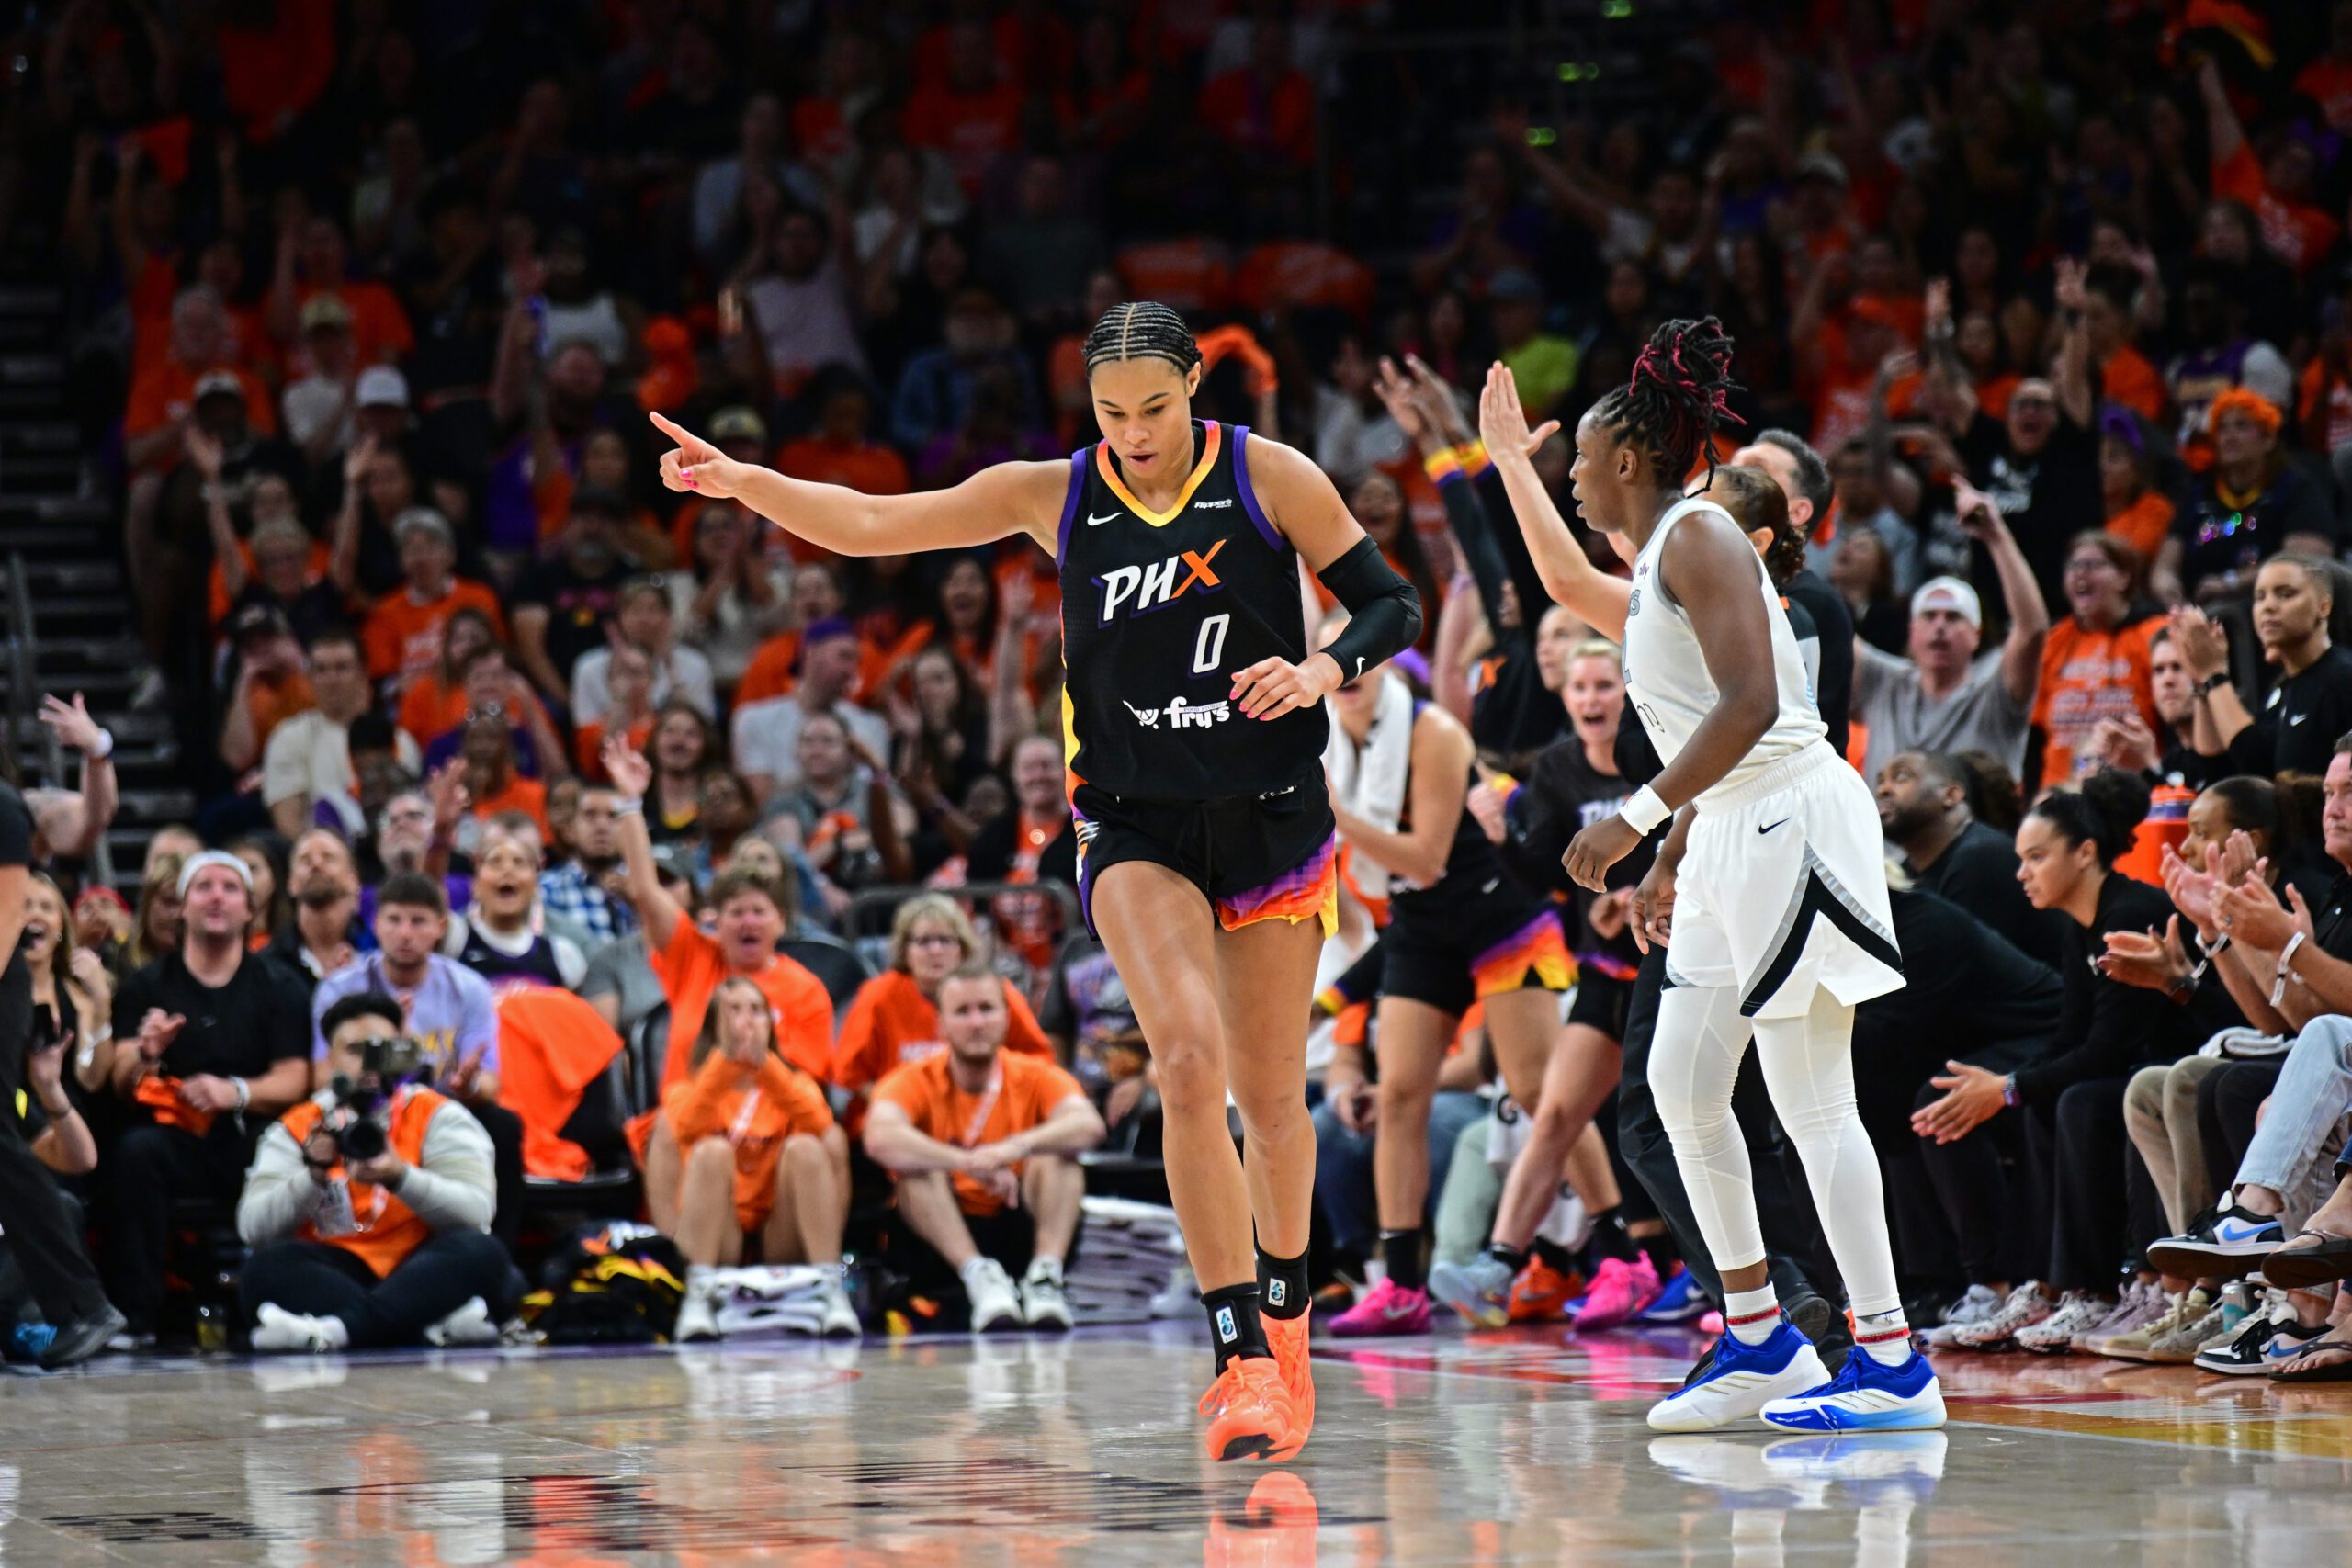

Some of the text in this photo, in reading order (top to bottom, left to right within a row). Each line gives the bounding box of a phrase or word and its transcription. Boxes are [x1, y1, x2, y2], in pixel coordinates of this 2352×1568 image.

[1101, 539, 1227, 622] PHX
[1193, 613, 1230, 673] 0
[1163, 696, 1230, 728] fry's
